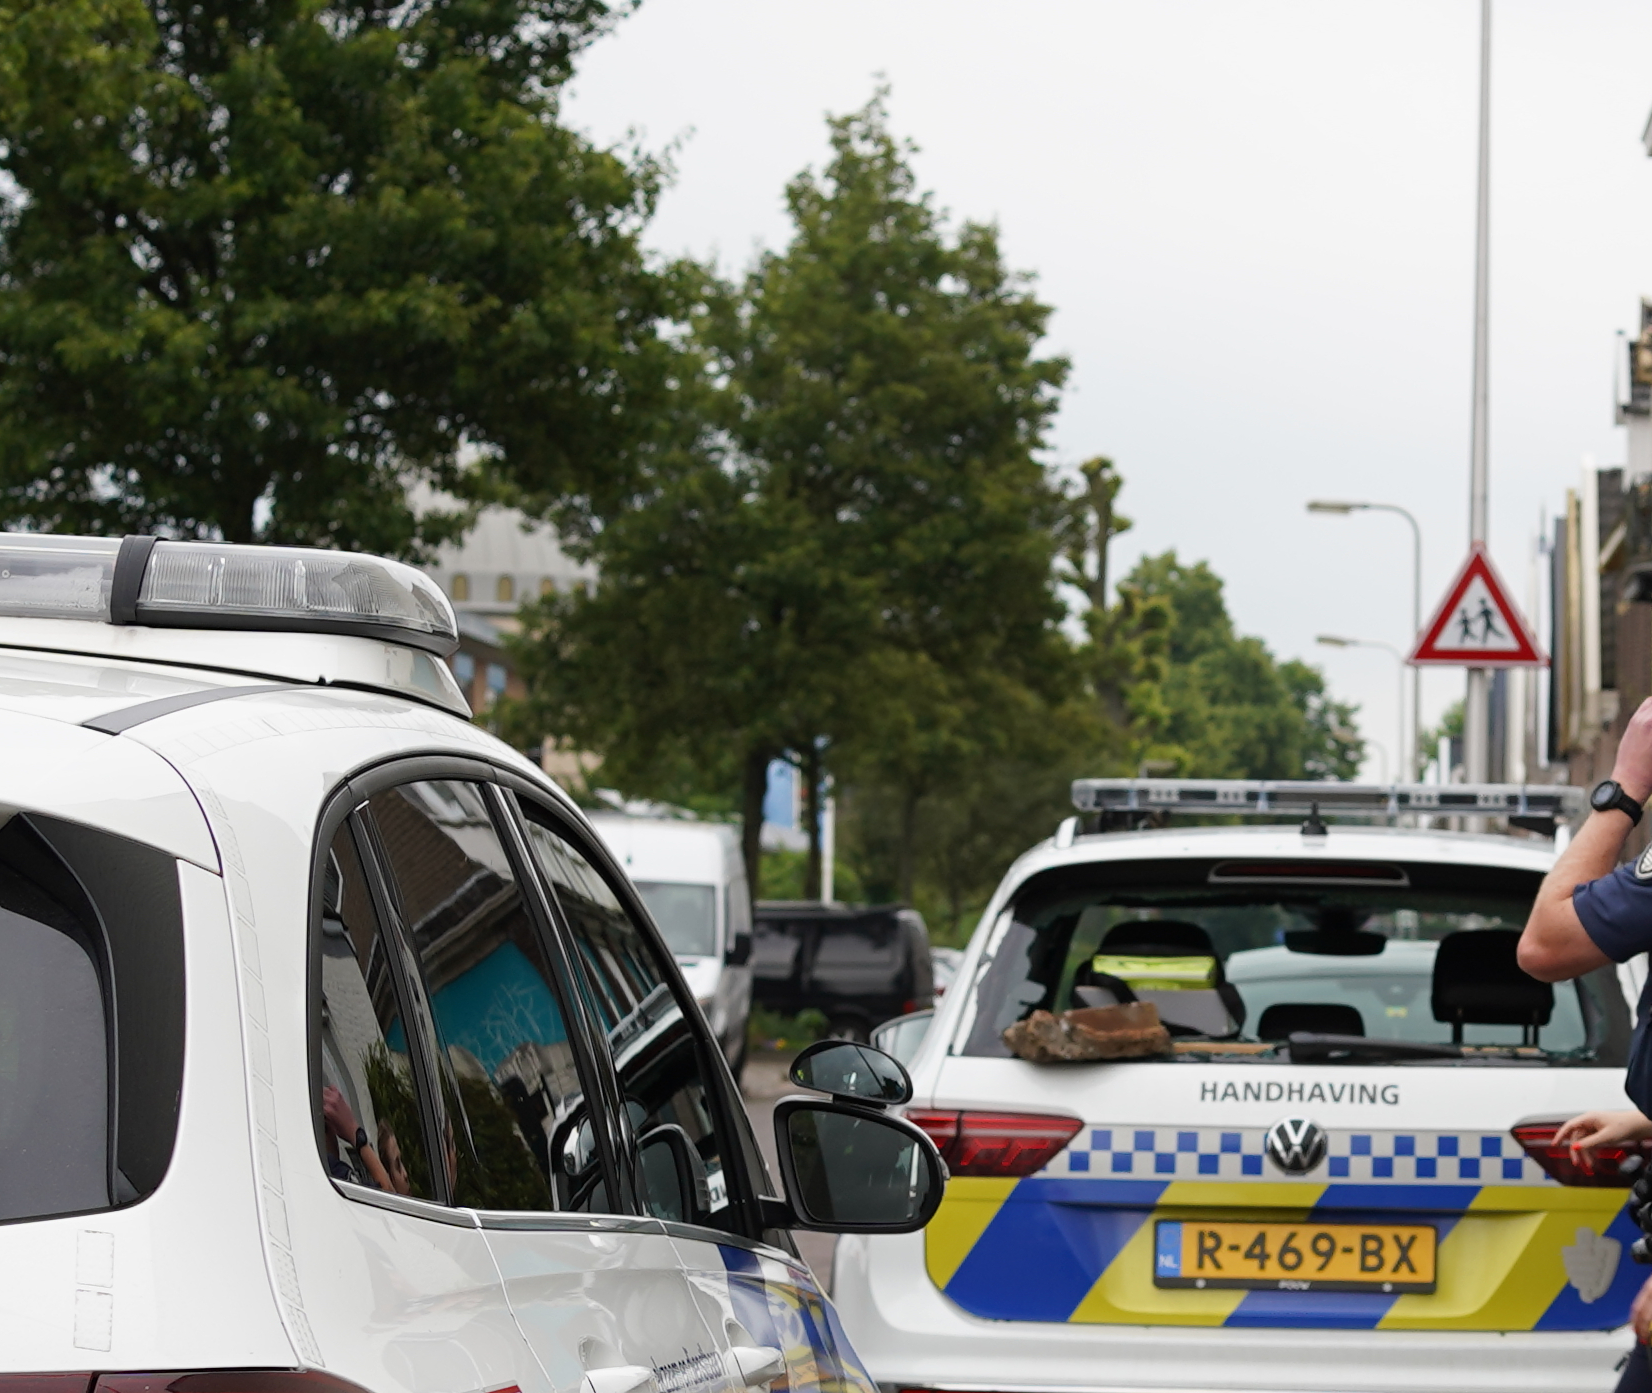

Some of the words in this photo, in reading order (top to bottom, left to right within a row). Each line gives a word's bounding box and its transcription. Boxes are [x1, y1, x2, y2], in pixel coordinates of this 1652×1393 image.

[1200, 1080, 1400, 1106] HANDHAVING
[1157, 1253, 1179, 1270] NL
[1196, 1228, 1418, 1274] R-469-BX
